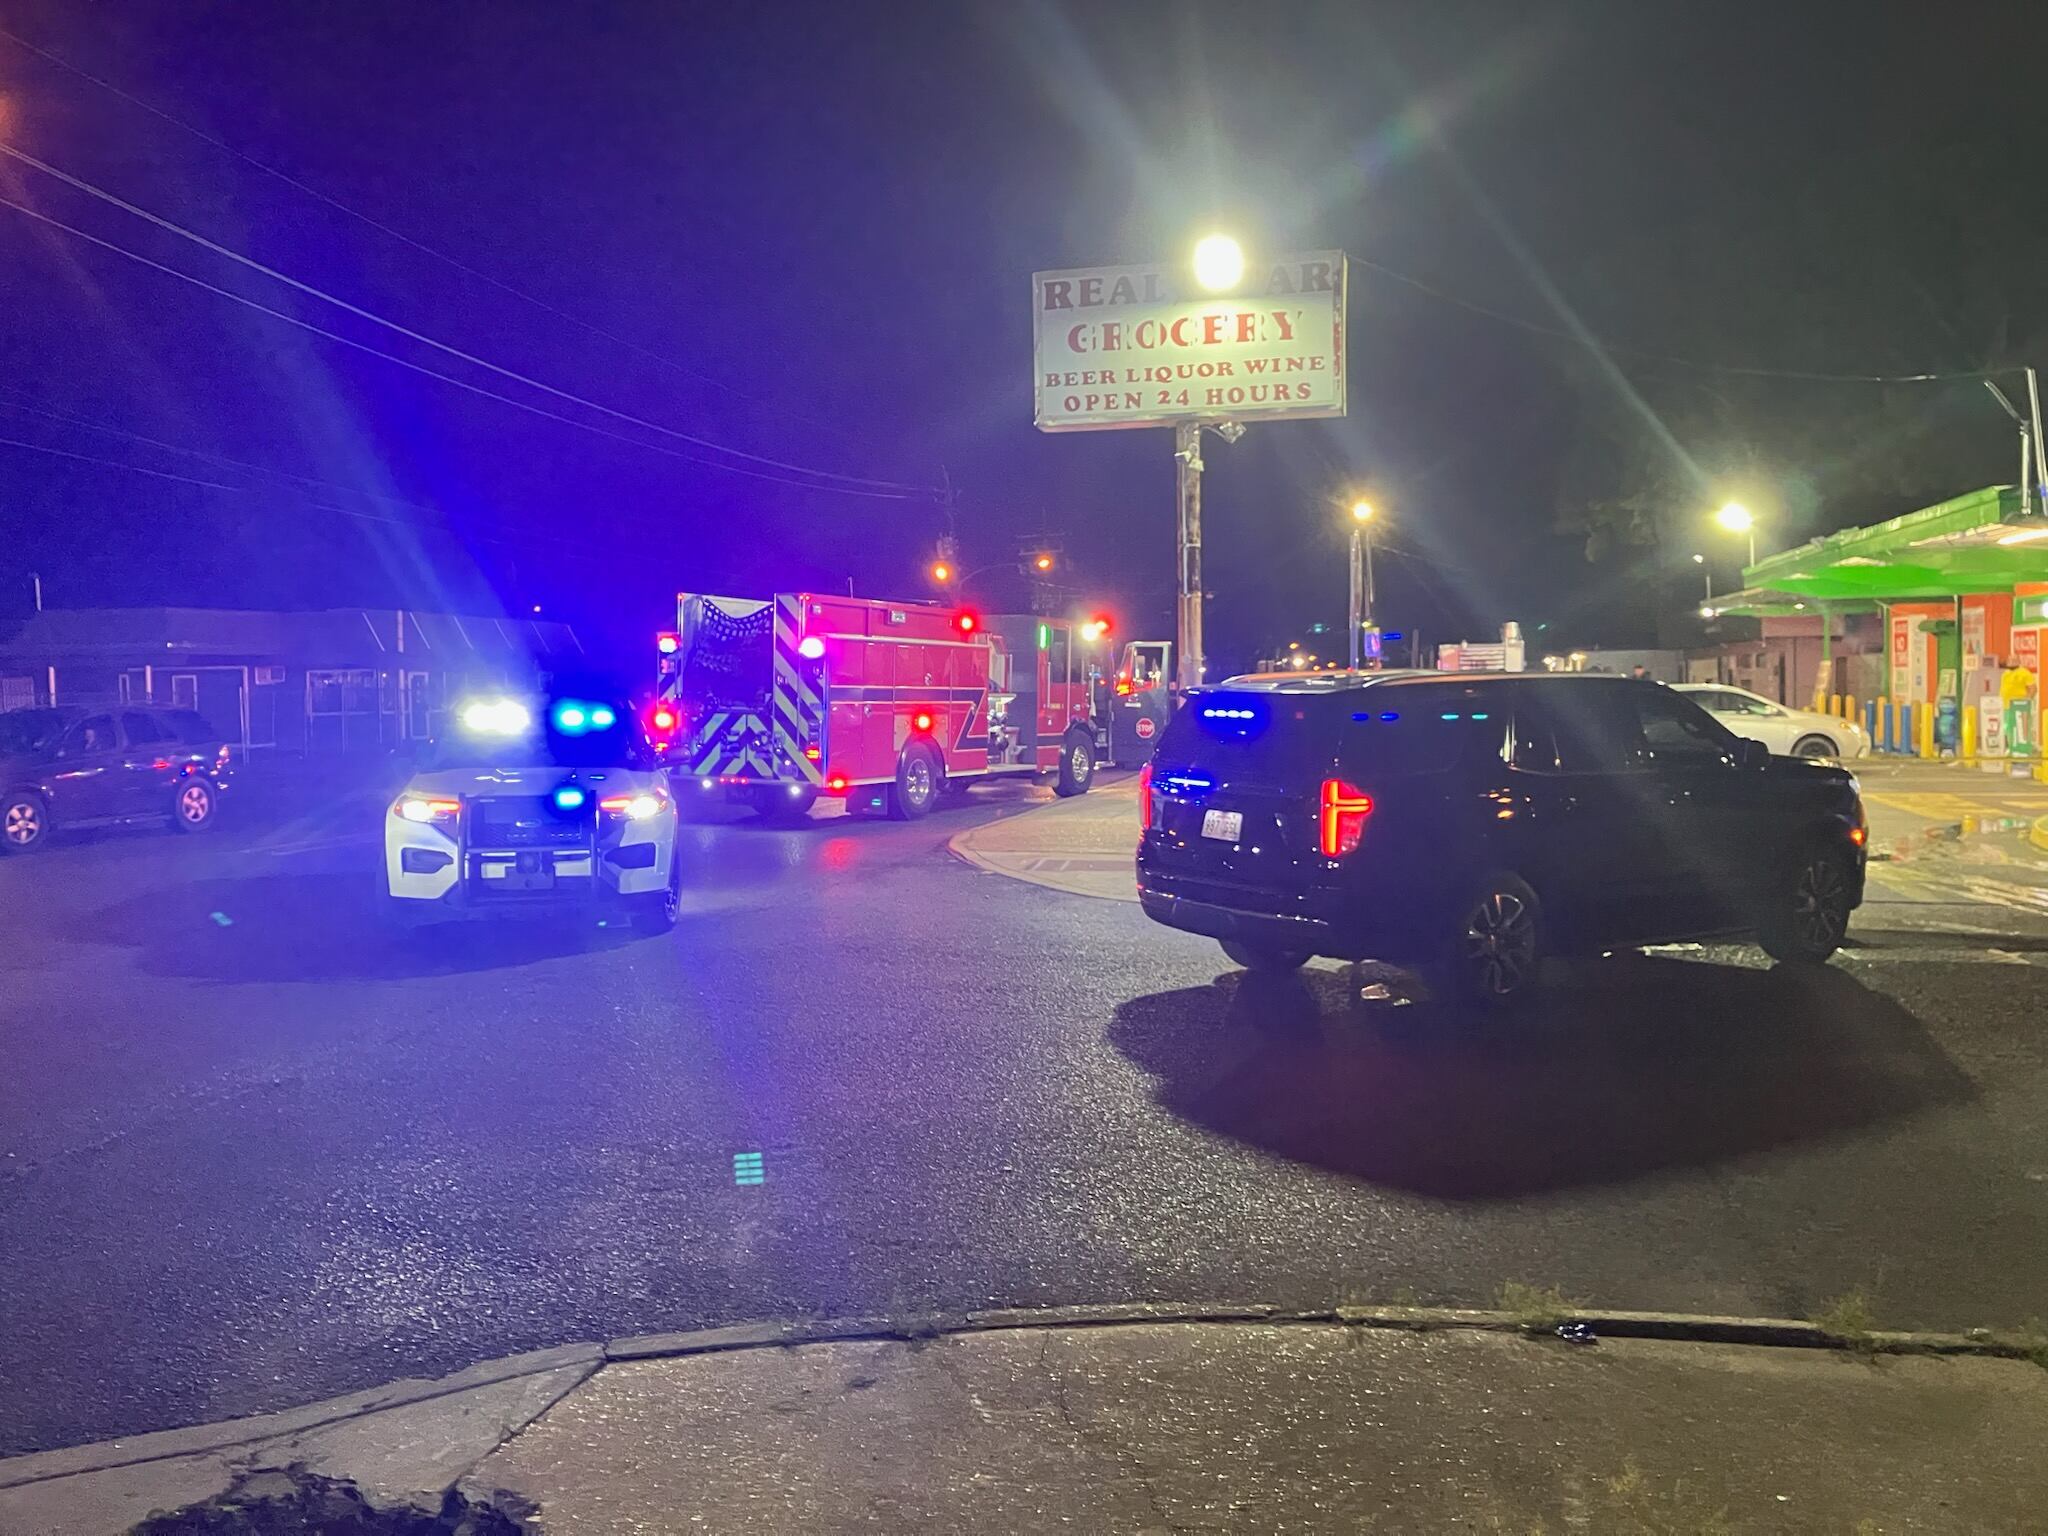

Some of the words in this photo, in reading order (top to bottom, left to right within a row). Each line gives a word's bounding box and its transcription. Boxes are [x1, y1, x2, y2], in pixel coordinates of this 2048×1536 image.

[1044, 274, 1167, 311] REAL
[1067, 310, 1303, 354] GROCERY
[1045, 370, 1117, 387] BEER
[1126, 361, 1234, 384] LIQUOR
[1244, 356, 1325, 375] WINE
[1064, 392, 1142, 412] OPEN
[1157, 389, 1190, 406] 24
[1206, 382, 1312, 405] HOURS
[1138, 724, 1154, 733] STOP
